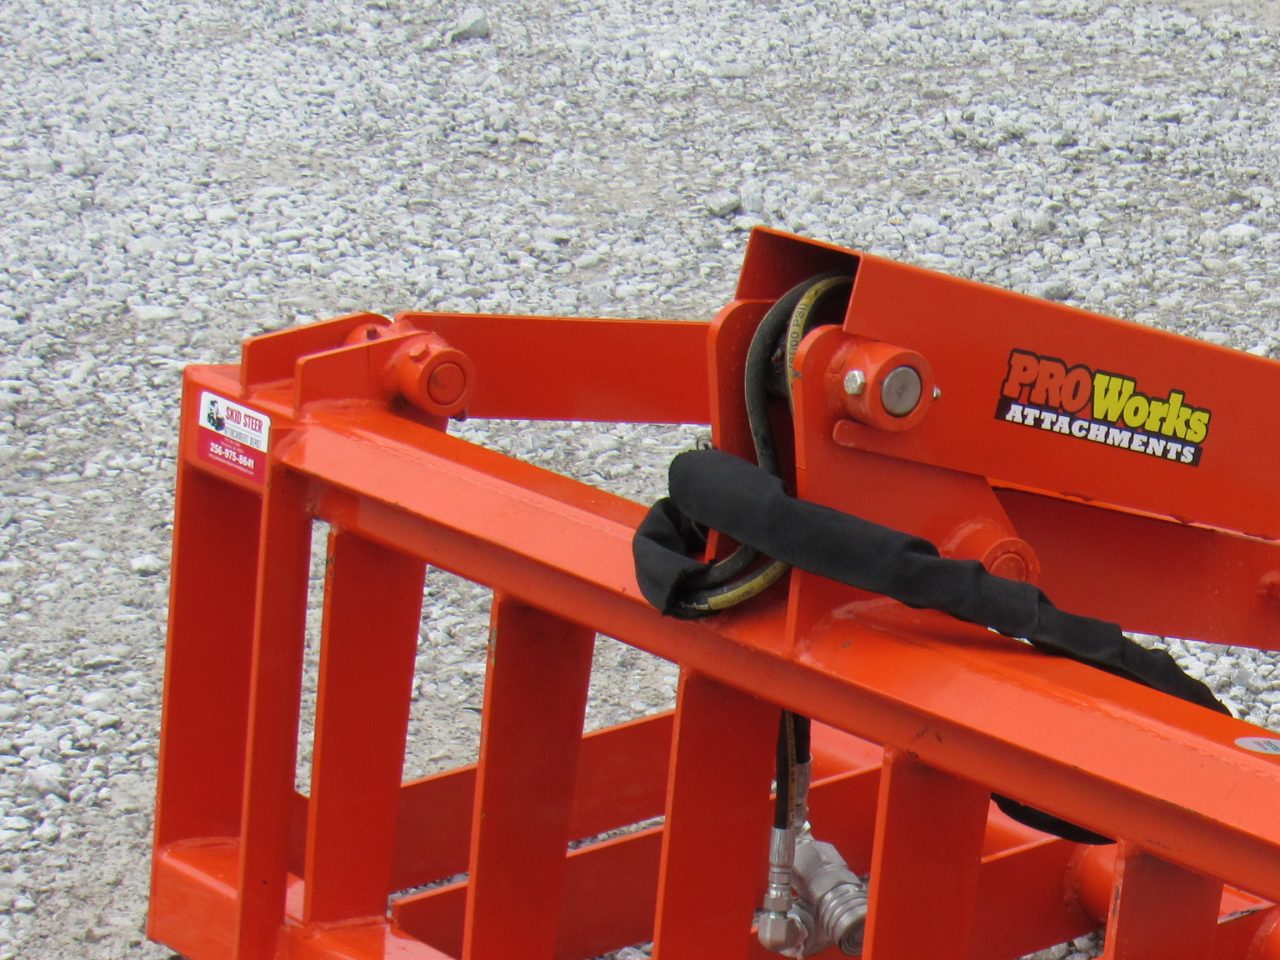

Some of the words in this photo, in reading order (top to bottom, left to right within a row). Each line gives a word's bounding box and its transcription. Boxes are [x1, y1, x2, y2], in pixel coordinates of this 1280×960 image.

[225, 406, 242, 425] SKID
[243, 414, 263, 434] STEER
[1001, 350, 1211, 443] PROWorks
[1005, 403, 1196, 464] ATTACHMENTS
